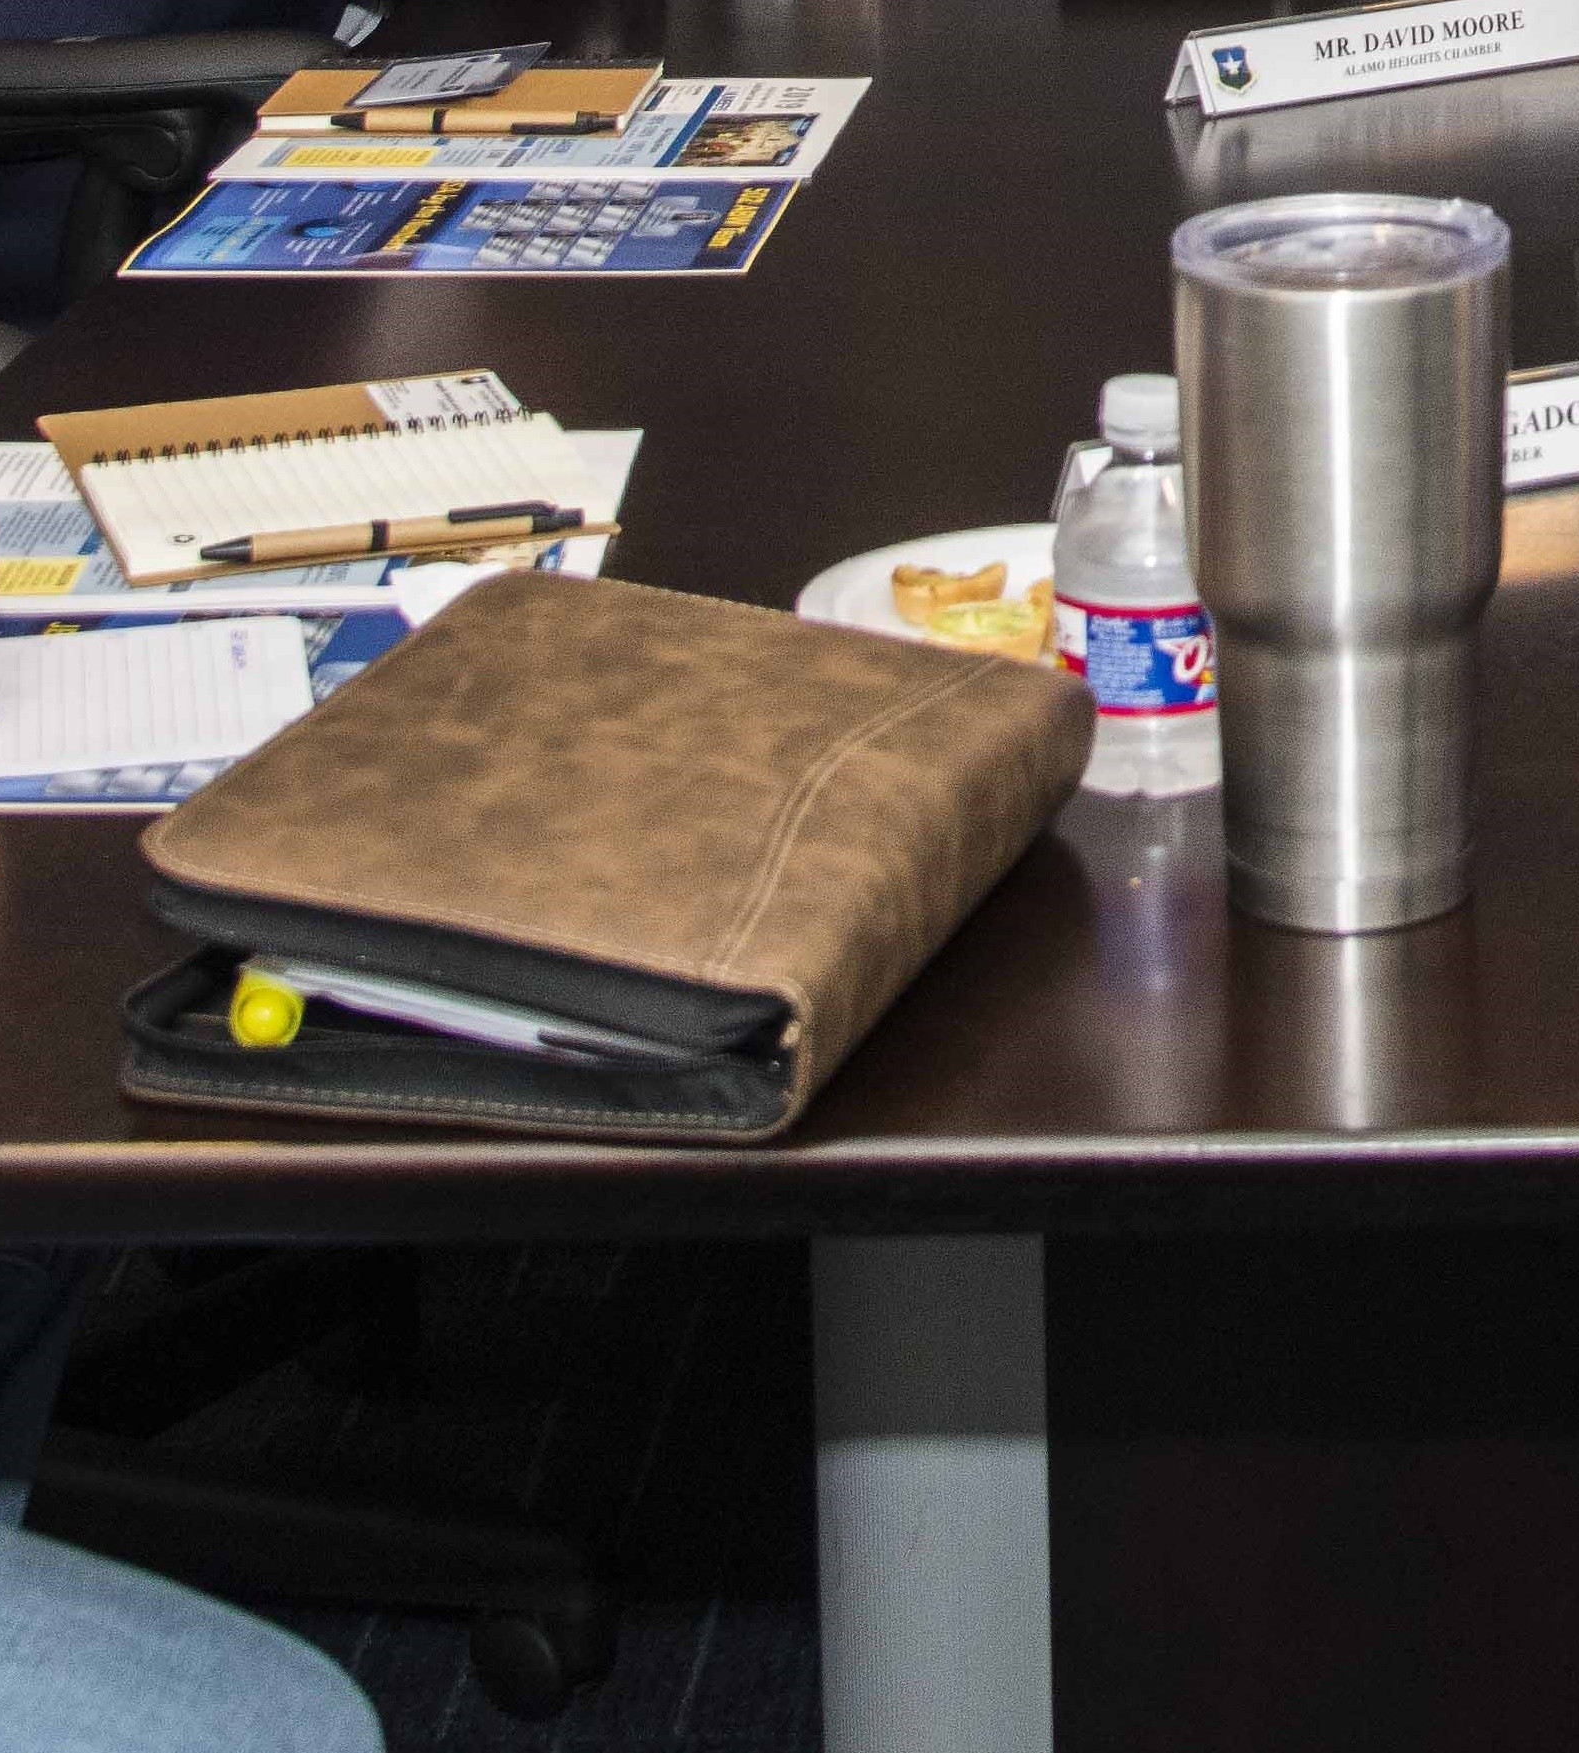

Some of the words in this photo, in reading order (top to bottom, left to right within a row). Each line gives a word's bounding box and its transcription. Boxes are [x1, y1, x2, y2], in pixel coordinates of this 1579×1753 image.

[1315, 36, 1356, 62] MR.
[1364, 25, 1435, 53] DAVID
[1441, 9, 1525, 42] MOORE
[1344, 58, 1386, 78] ALAMO
[1388, 50, 1442, 71] HEIGHTS
[1444, 42, 1502, 64] CHAMBER
